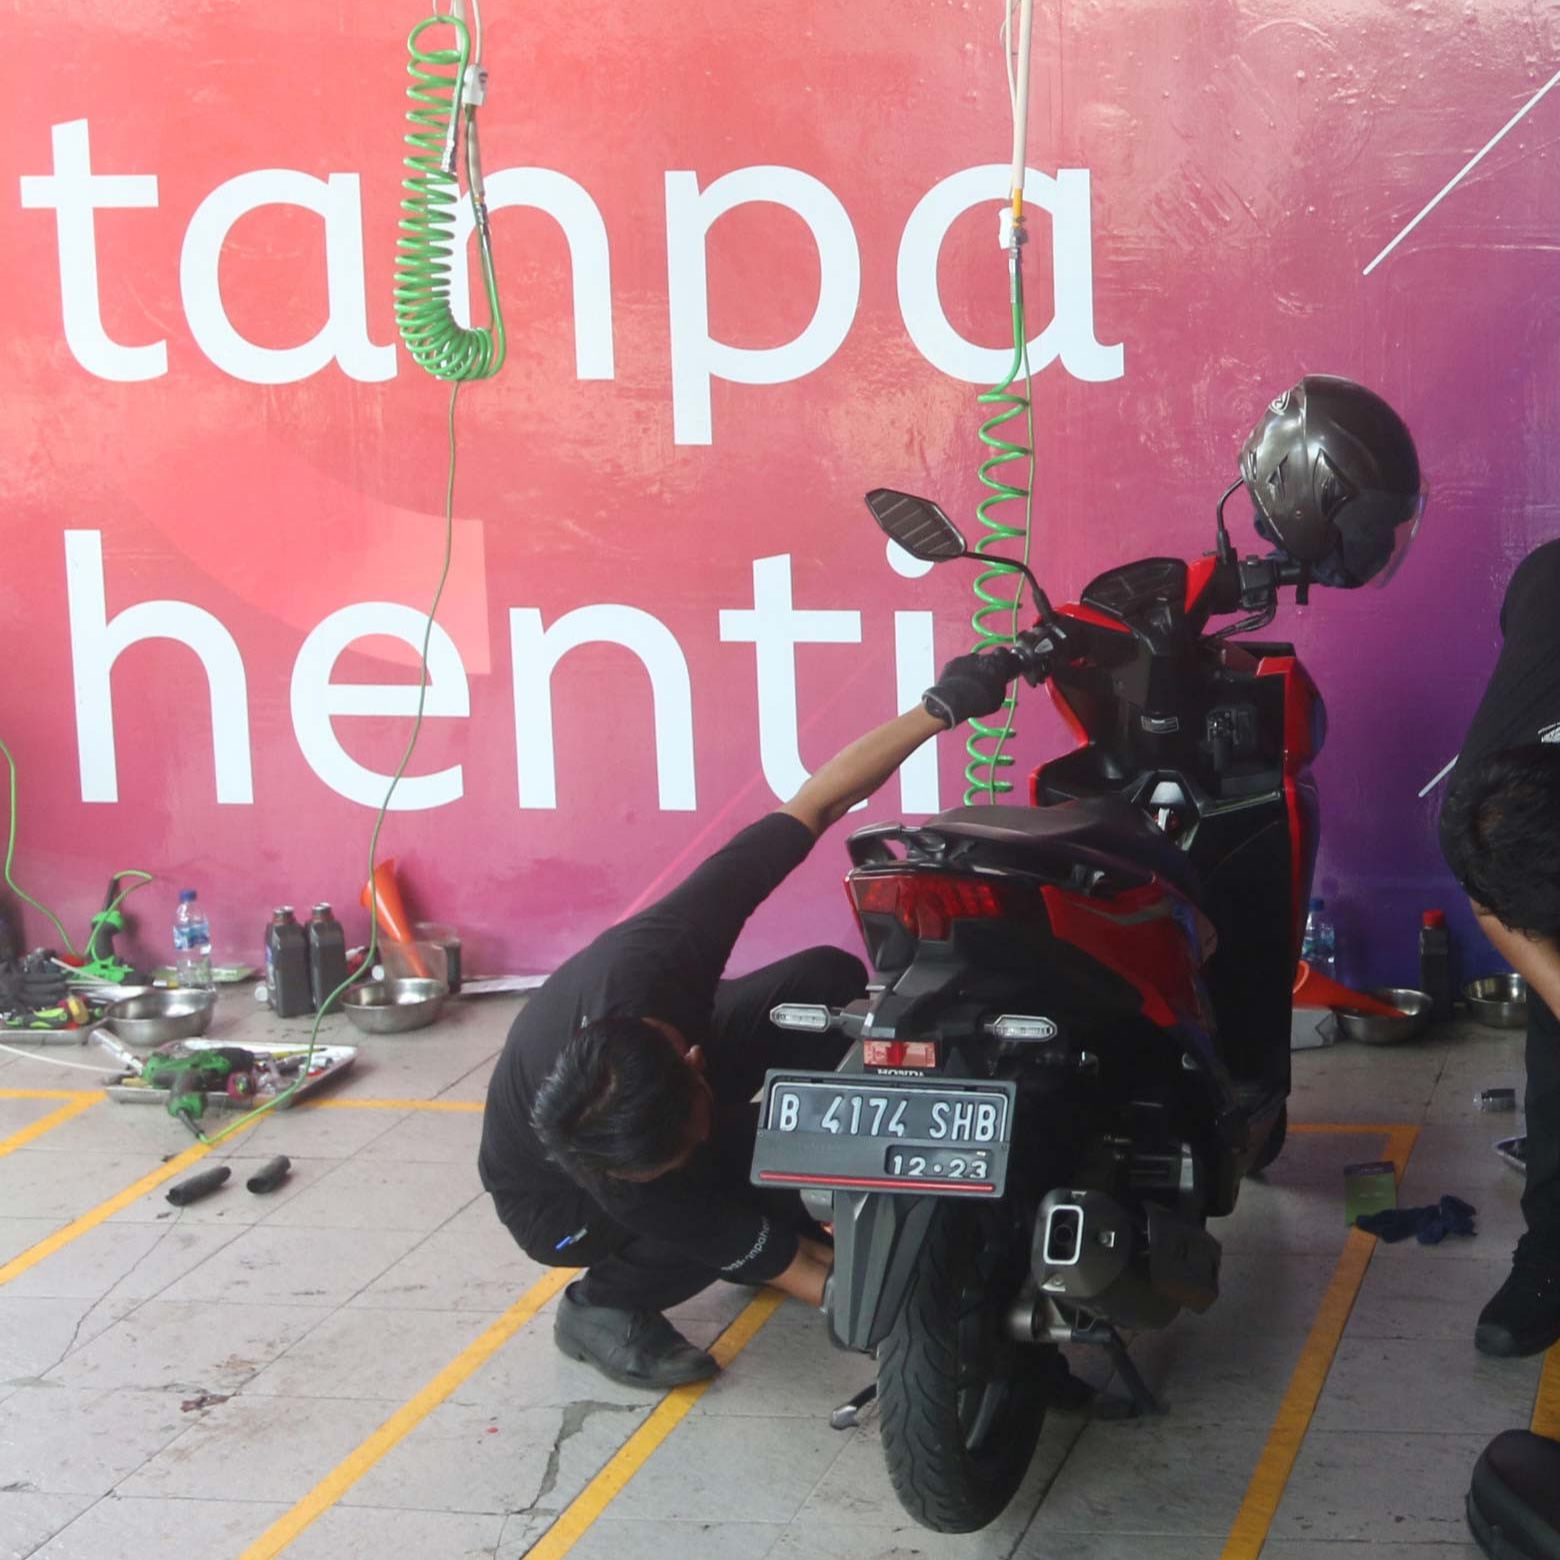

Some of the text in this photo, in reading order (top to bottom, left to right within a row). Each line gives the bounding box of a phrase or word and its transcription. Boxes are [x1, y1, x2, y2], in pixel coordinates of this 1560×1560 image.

[20, 118, 1125, 445] tanpa
[63, 528, 941, 815] henti
[779, 1094, 997, 1142] B 4174 SHB
